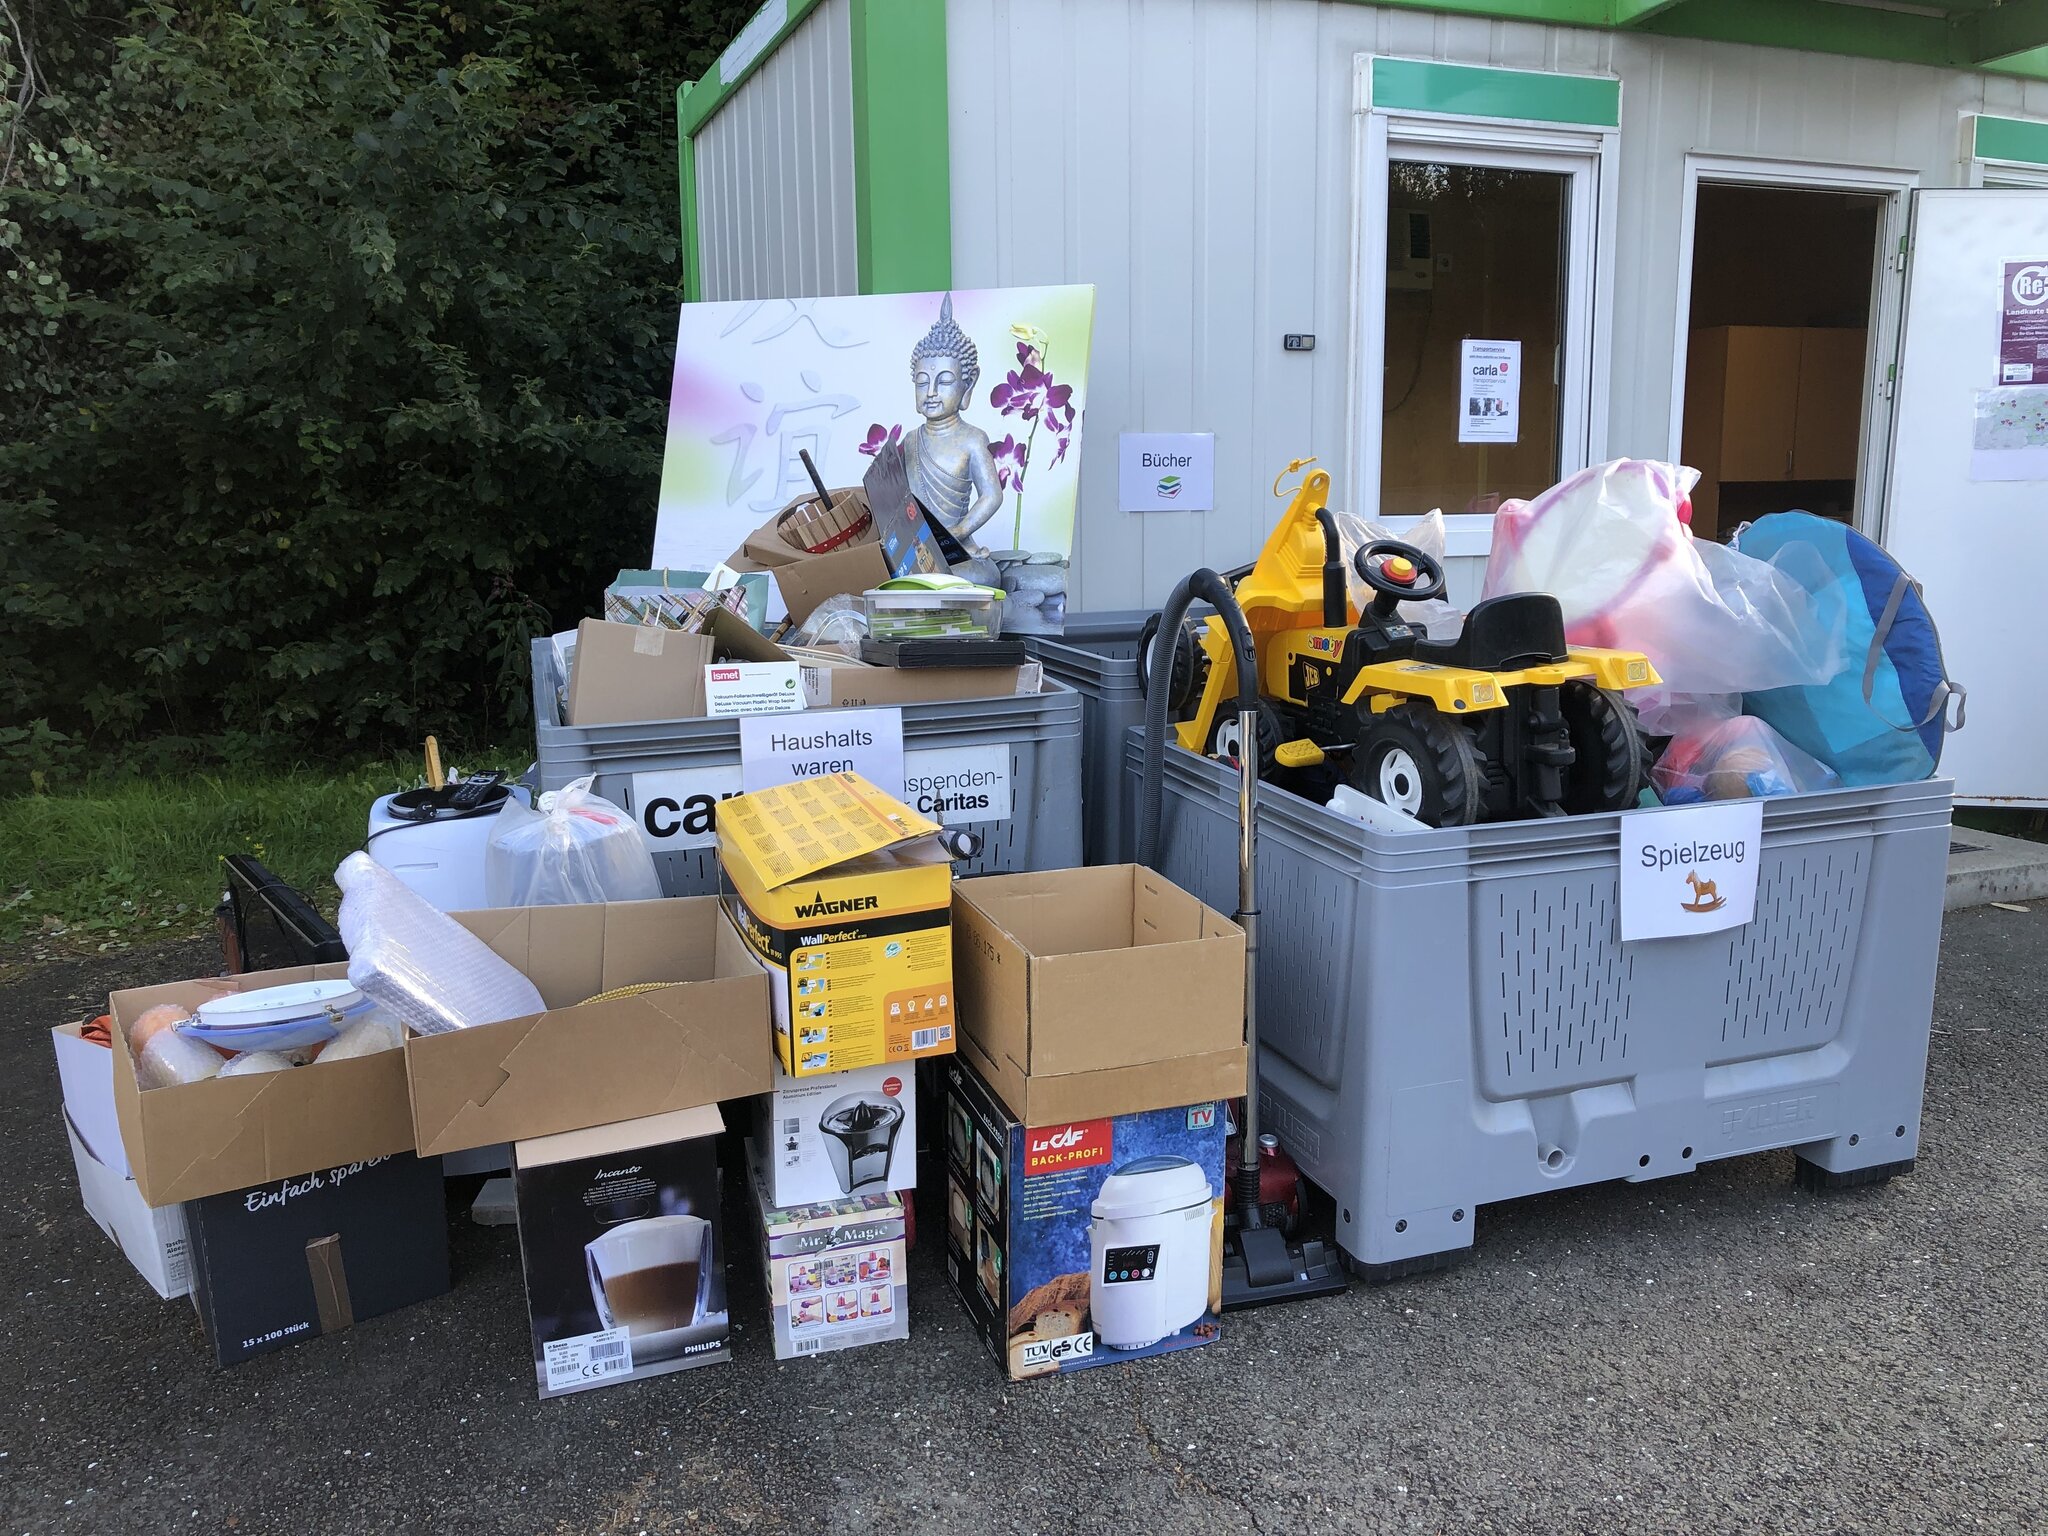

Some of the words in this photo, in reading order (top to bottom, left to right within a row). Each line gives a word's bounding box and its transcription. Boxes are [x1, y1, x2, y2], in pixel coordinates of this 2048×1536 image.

[1473, 364, 1498, 376] carla
[1142, 452, 1192, 467] Bücher
[1308, 634, 1343, 658] smoby
[713, 671, 739, 680] ismet
[1304, 664, 1319, 687] JCB
[771, 729, 873, 752] Haushalts
[791, 758, 853, 777] waren
[917, 792, 990, 814] Caritas
[1641, 840, 1745, 871] Spielzeug
[794, 890, 879, 918] WAGNER
[1192, 1110, 1212, 1124] TV
[1031, 1147, 1103, 1167] BACK-PROFI
[594, 1165, 642, 1180] Incanto
[244, 1172, 324, 1212] Einfach
[800, 1235, 823, 1249] Mr.
[843, 1225, 888, 1241] Magic
[242, 1338, 255, 1348] 15
[264, 1330, 282, 1342] 100
[284, 1321, 310, 1335] Stück
[684, 1340, 721, 1354] PHILIPS
[1024, 1343, 1050, 1356] TÜV
[1052, 1339, 1072, 1357] GS
